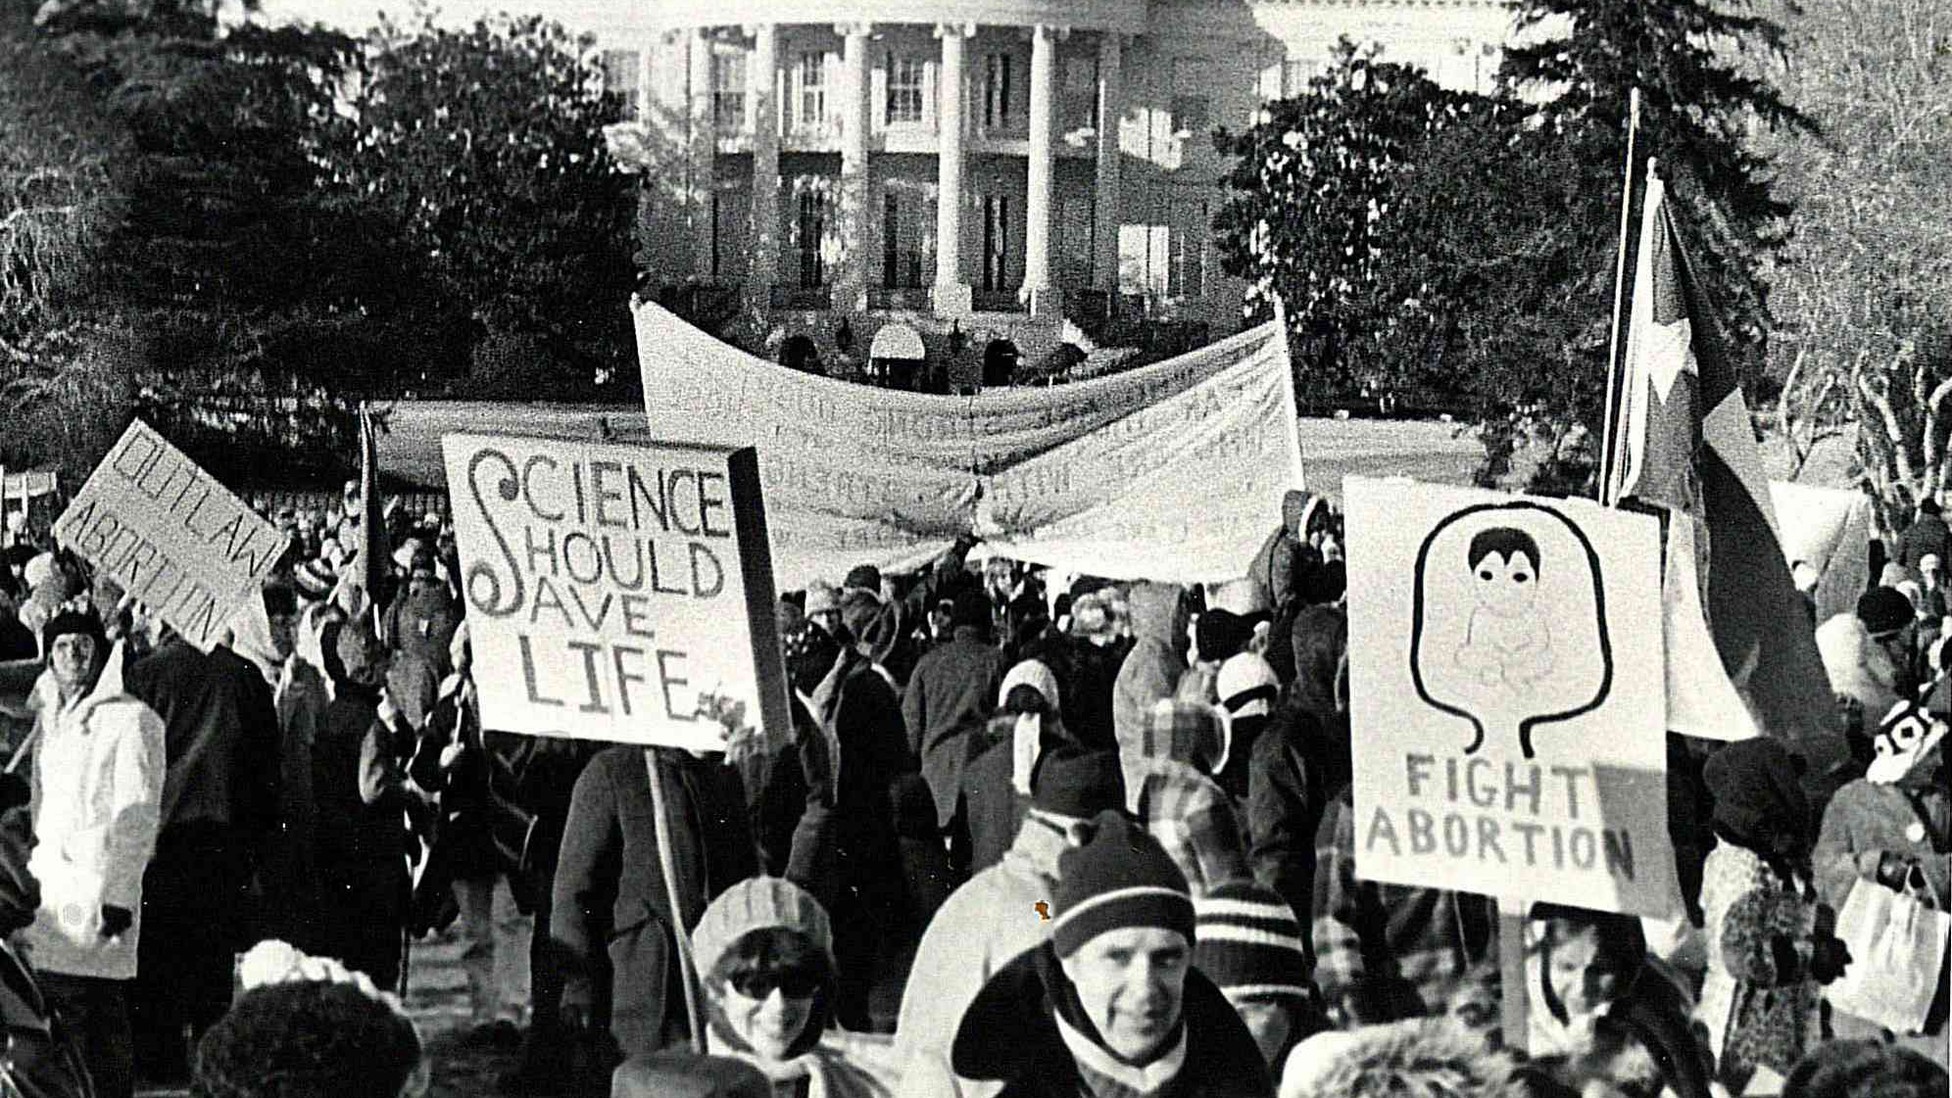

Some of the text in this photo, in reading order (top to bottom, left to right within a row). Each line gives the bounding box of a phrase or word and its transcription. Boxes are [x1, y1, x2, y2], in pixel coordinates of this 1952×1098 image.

[113, 430, 279, 577] OUTLAW
[468, 449, 730, 538] SCIENCE
[62, 501, 228, 642] ABORTION
[518, 635, 700, 722] LIFE
[1406, 753, 1589, 819] FIGHT
[1366, 806, 1636, 881] ABORTION
